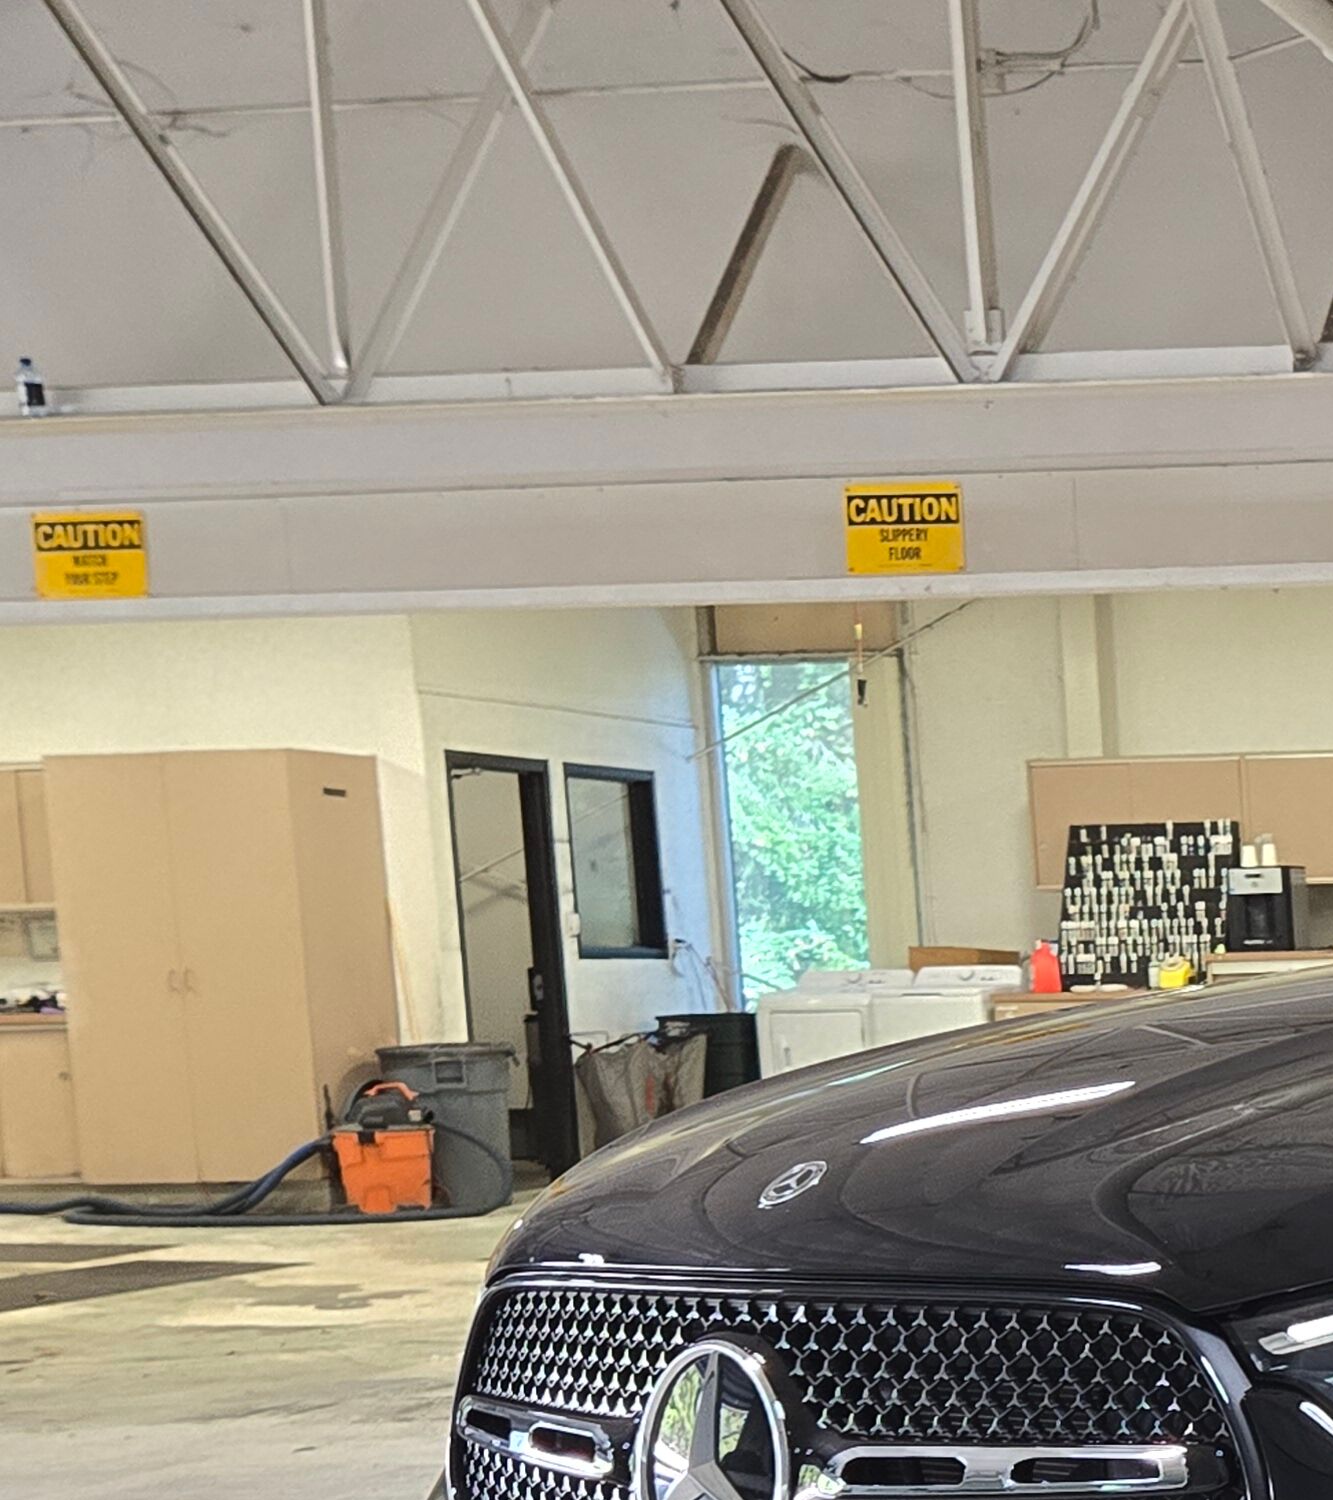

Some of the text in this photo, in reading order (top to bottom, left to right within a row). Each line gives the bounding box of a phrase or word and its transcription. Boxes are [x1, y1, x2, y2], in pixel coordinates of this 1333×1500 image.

[848, 495, 958, 523] CAUTION
[37, 522, 140, 549] CAUTION
[879, 528, 929, 543] SLIPPERY
[888, 546, 922, 561] FLOOR
